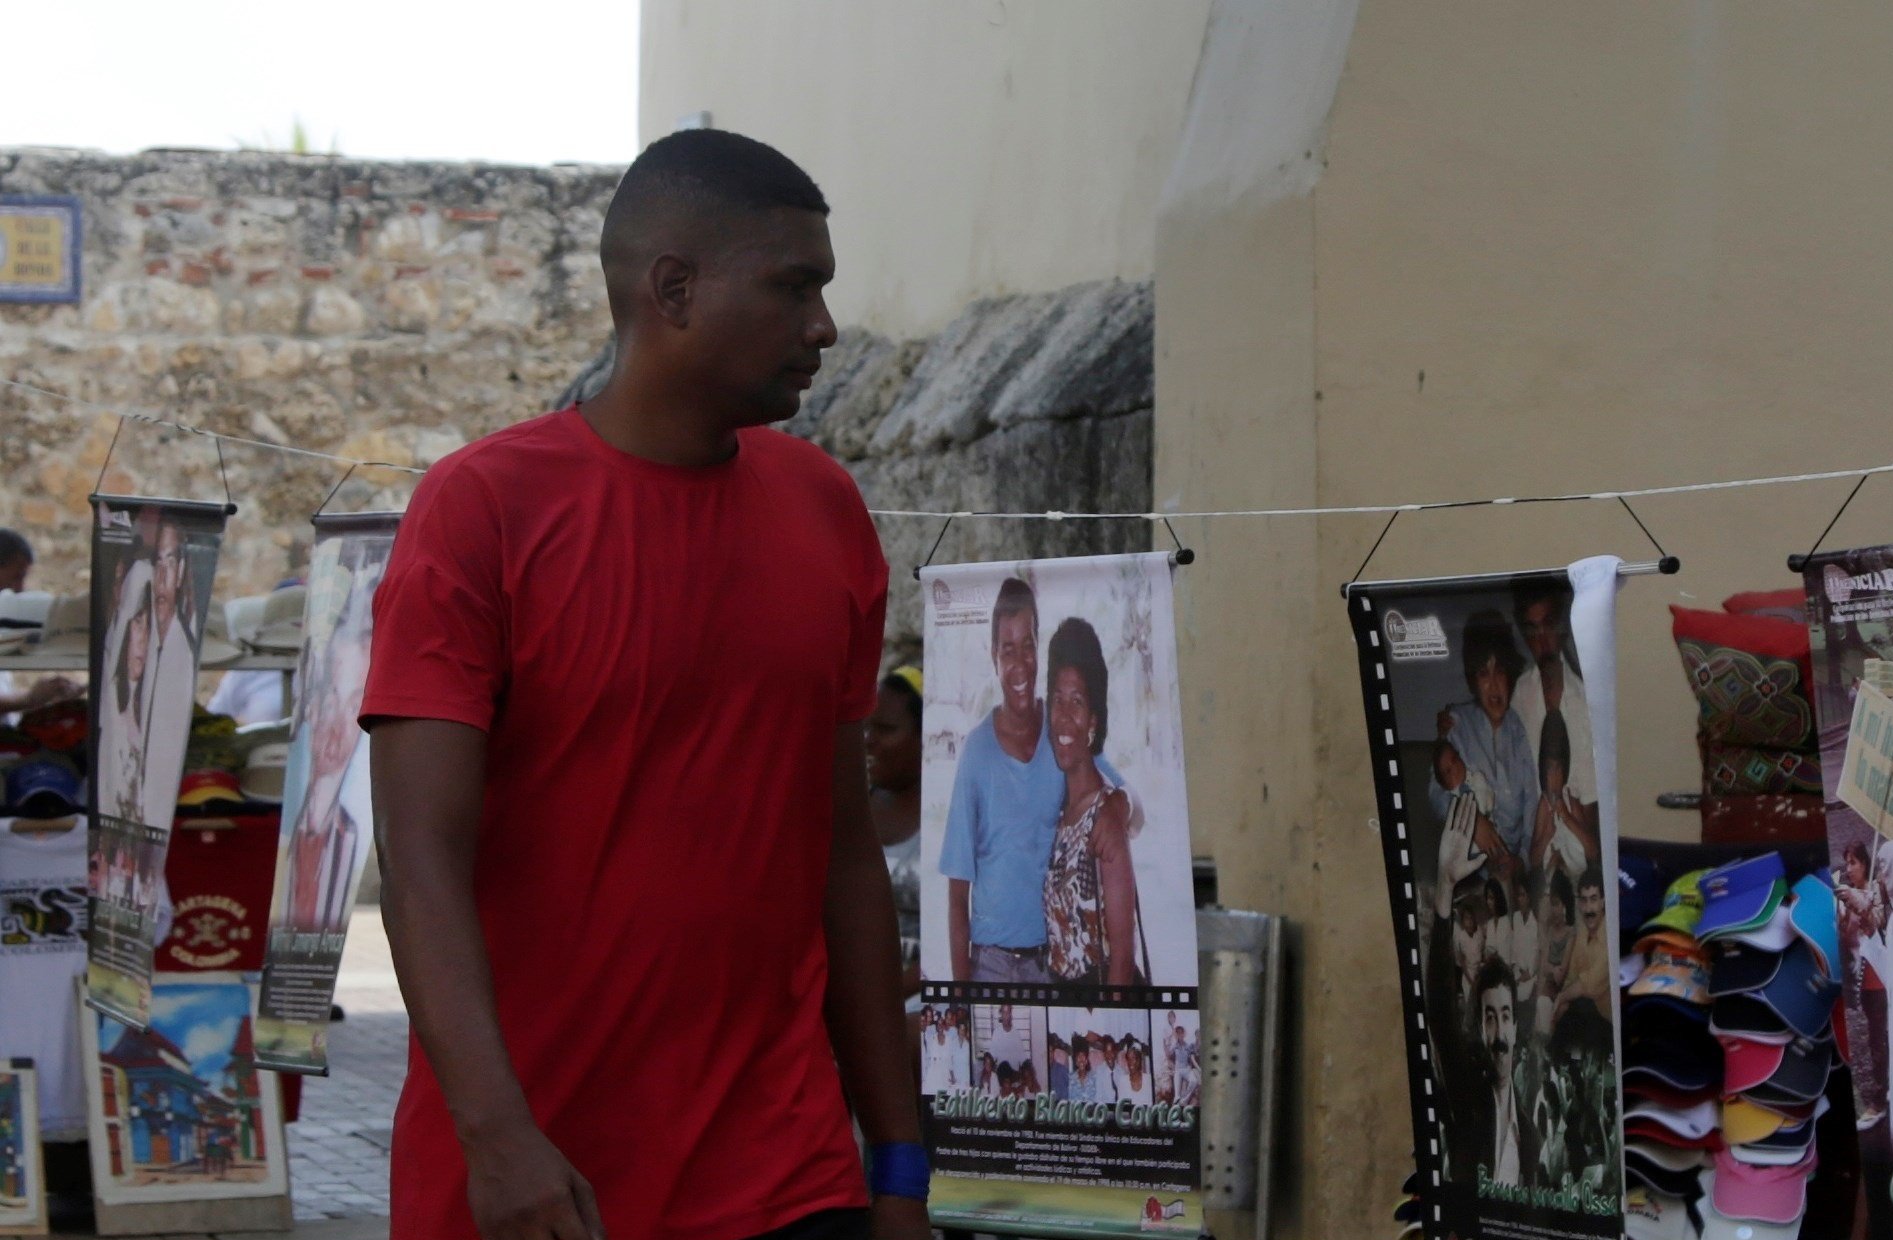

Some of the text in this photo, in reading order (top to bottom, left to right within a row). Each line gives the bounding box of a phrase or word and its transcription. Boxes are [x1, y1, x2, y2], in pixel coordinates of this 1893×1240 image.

[933, 1086, 1196, 1132] Edilberto Blanco Cortés
